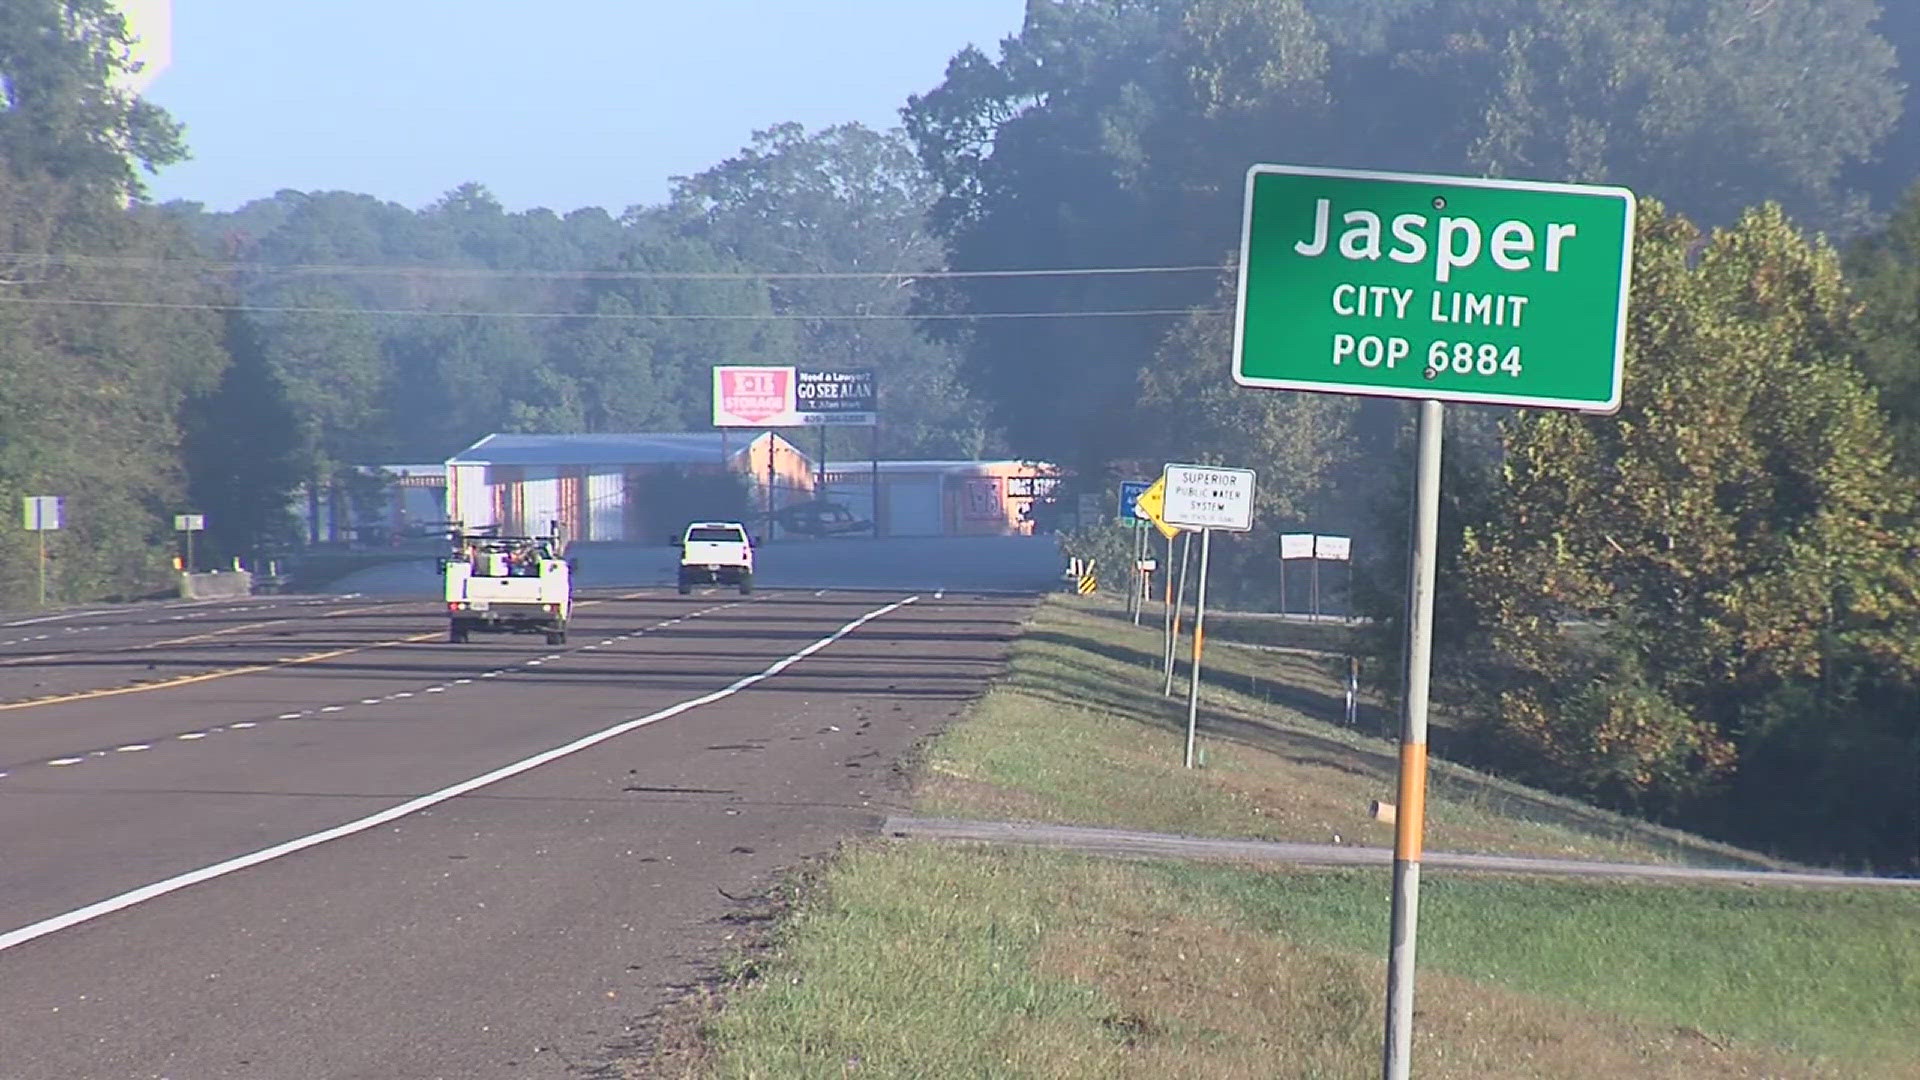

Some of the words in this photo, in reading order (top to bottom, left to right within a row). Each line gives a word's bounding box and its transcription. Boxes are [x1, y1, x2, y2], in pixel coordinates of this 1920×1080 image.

[1294, 199, 1577, 282] Jasper
[1332, 284, 1413, 319] CITY
[1431, 291, 1528, 327] LIMIT
[1332, 334, 1409, 369] POP
[1427, 341, 1523, 378] 6884
[800, 373, 823, 382] Need
[798, 383, 816, 398] GO
[816, 383, 839, 398] SEE
[840, 383, 872, 398] ALAN
[1182, 472, 1237, 486] SUPERIOR
[1176, 487, 1207, 498] PUBLIC
[1212, 490, 1241, 500] WATER
[1191, 501, 1224, 512] SYSTEM
